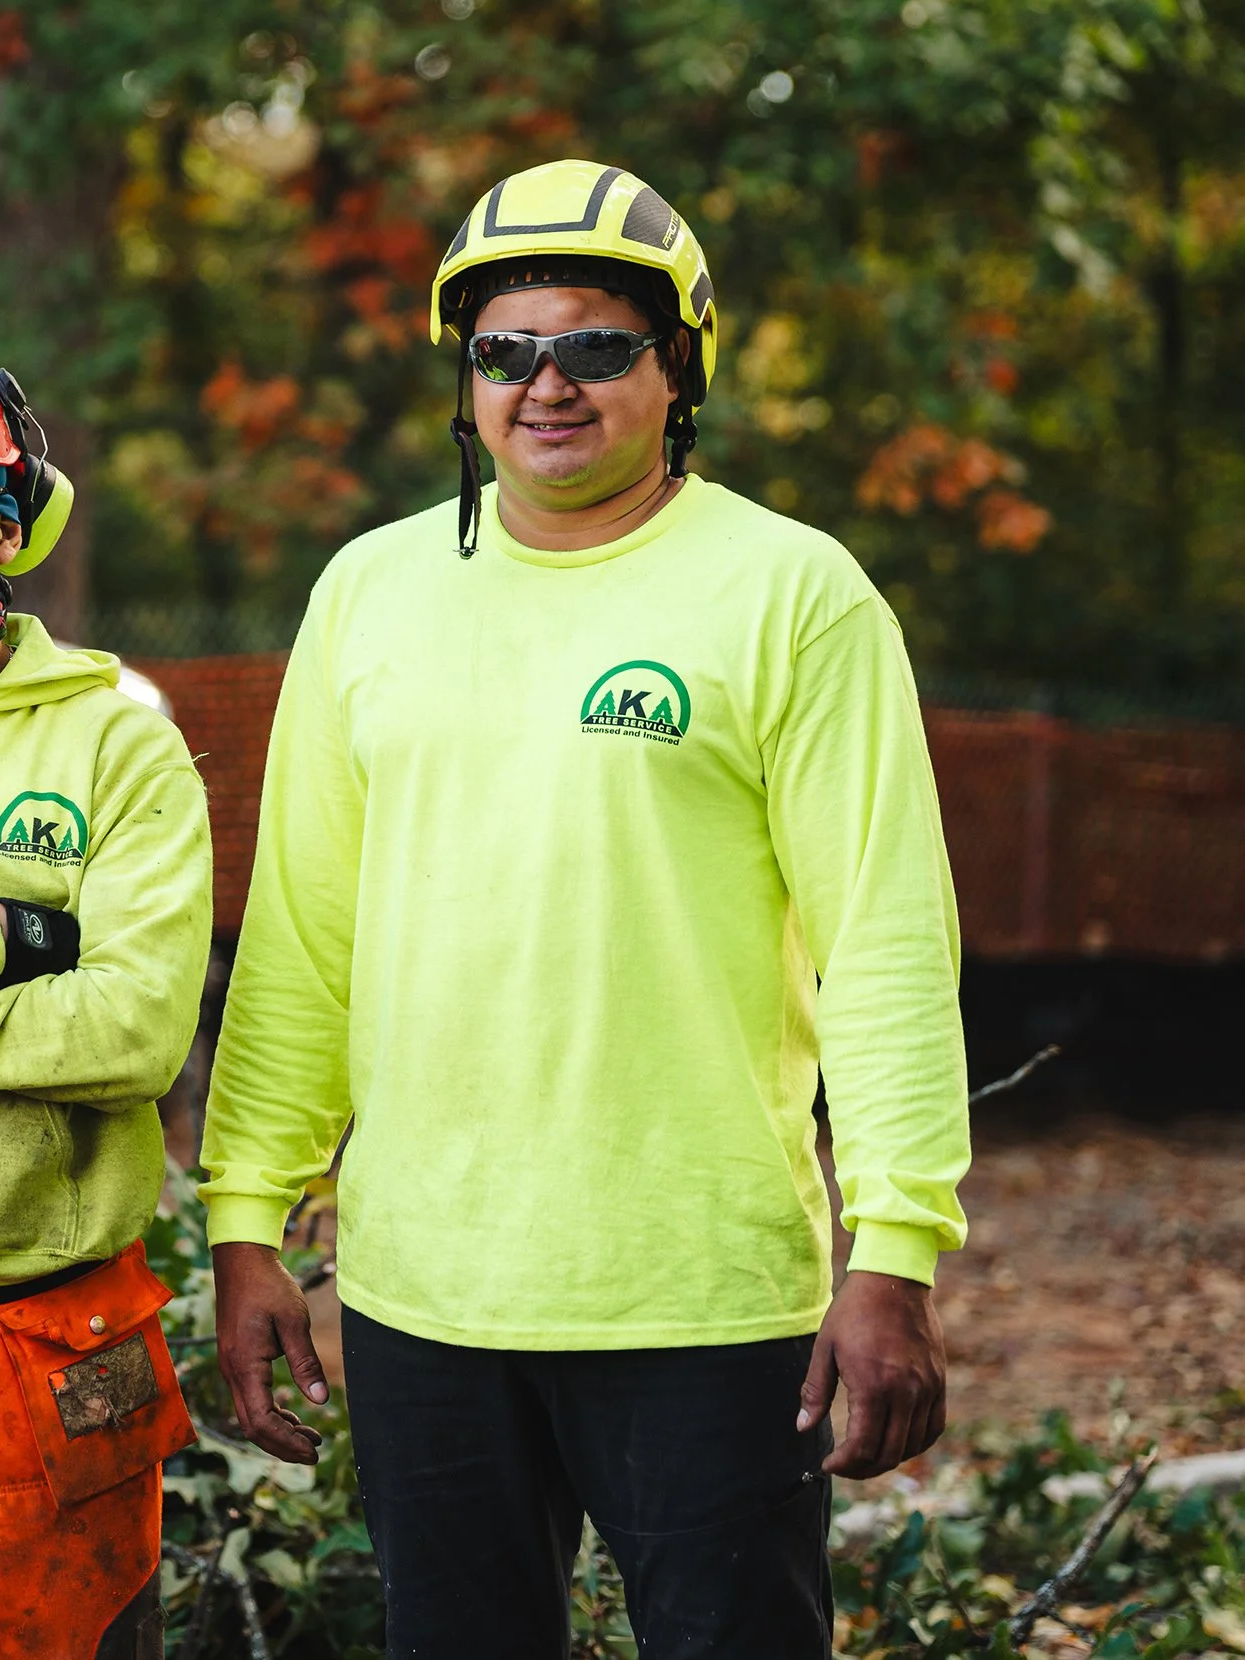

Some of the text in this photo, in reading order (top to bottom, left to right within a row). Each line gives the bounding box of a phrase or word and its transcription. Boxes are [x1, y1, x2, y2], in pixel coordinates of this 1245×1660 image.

[592, 716, 673, 734] TREE SERVICE
[581, 726, 680, 746] Licensed and Insured
[5, 844, 74, 860] TREE SERVICE
